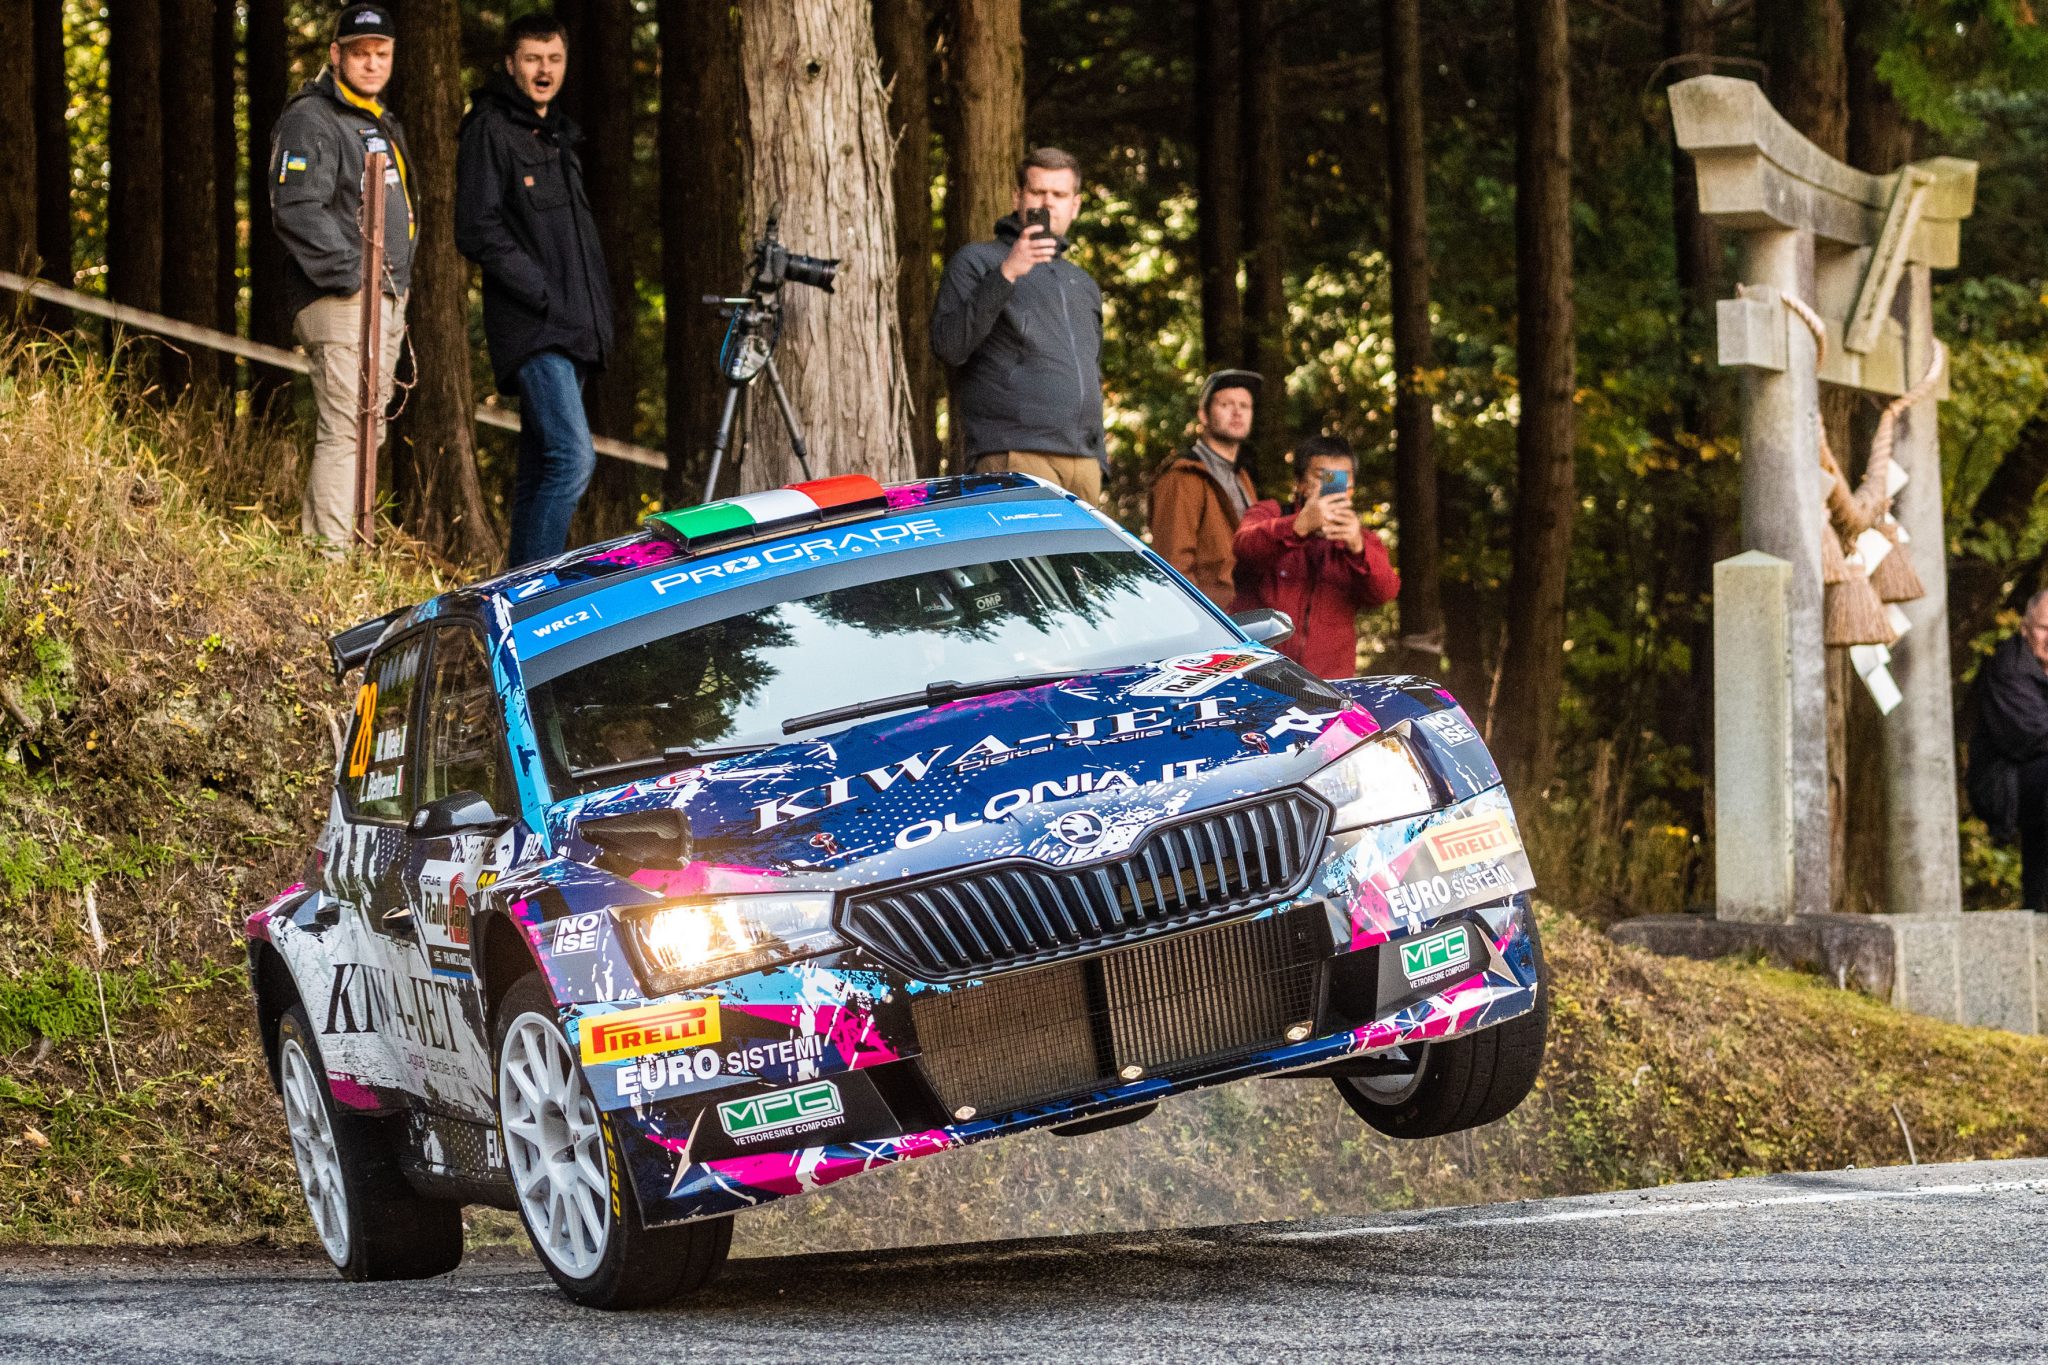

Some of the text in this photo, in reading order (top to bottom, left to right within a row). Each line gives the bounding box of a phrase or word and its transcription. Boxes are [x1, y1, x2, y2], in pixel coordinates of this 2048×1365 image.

[810, 531, 945, 562] DIGITAL
[976, 594, 1002, 610] OMP
[532, 610, 590, 638] WRC2
[1163, 671, 1220, 693] Rally
[1203, 654, 1257, 674] Japan
[349, 682, 378, 778] 28
[1427, 710, 1455, 730] NO
[1440, 724, 1472, 745] ISE
[751, 697, 1238, 834] KIWA-JET
[956, 742, 1054, 773] Digital
[1067, 728, 1164, 747] textile
[894, 757, 1207, 850] OLONIA.IT
[1431, 820, 1508, 862] PIRELLI
[1384, 864, 1515, 918] EURO SISTEMI
[425, 890, 467, 937] Rally Jap
[558, 913, 599, 935] NO
[555, 932, 596, 952] ISE
[1403, 928, 1468, 974] MPG
[1410, 961, 1470, 989] VETRORESINE COMPOSITI
[321, 963, 460, 1053] KIWA-JET
[592, 1007, 707, 1054] PIRELLI
[617, 1035, 823, 1096] EURO SISTEMI
[722, 1084, 840, 1130] MPG
[486, 1130, 503, 1169] EU
[733, 1115, 845, 1146] VETRORESINE COMPOSITI
[602, 1123, 621, 1218] ZERO
